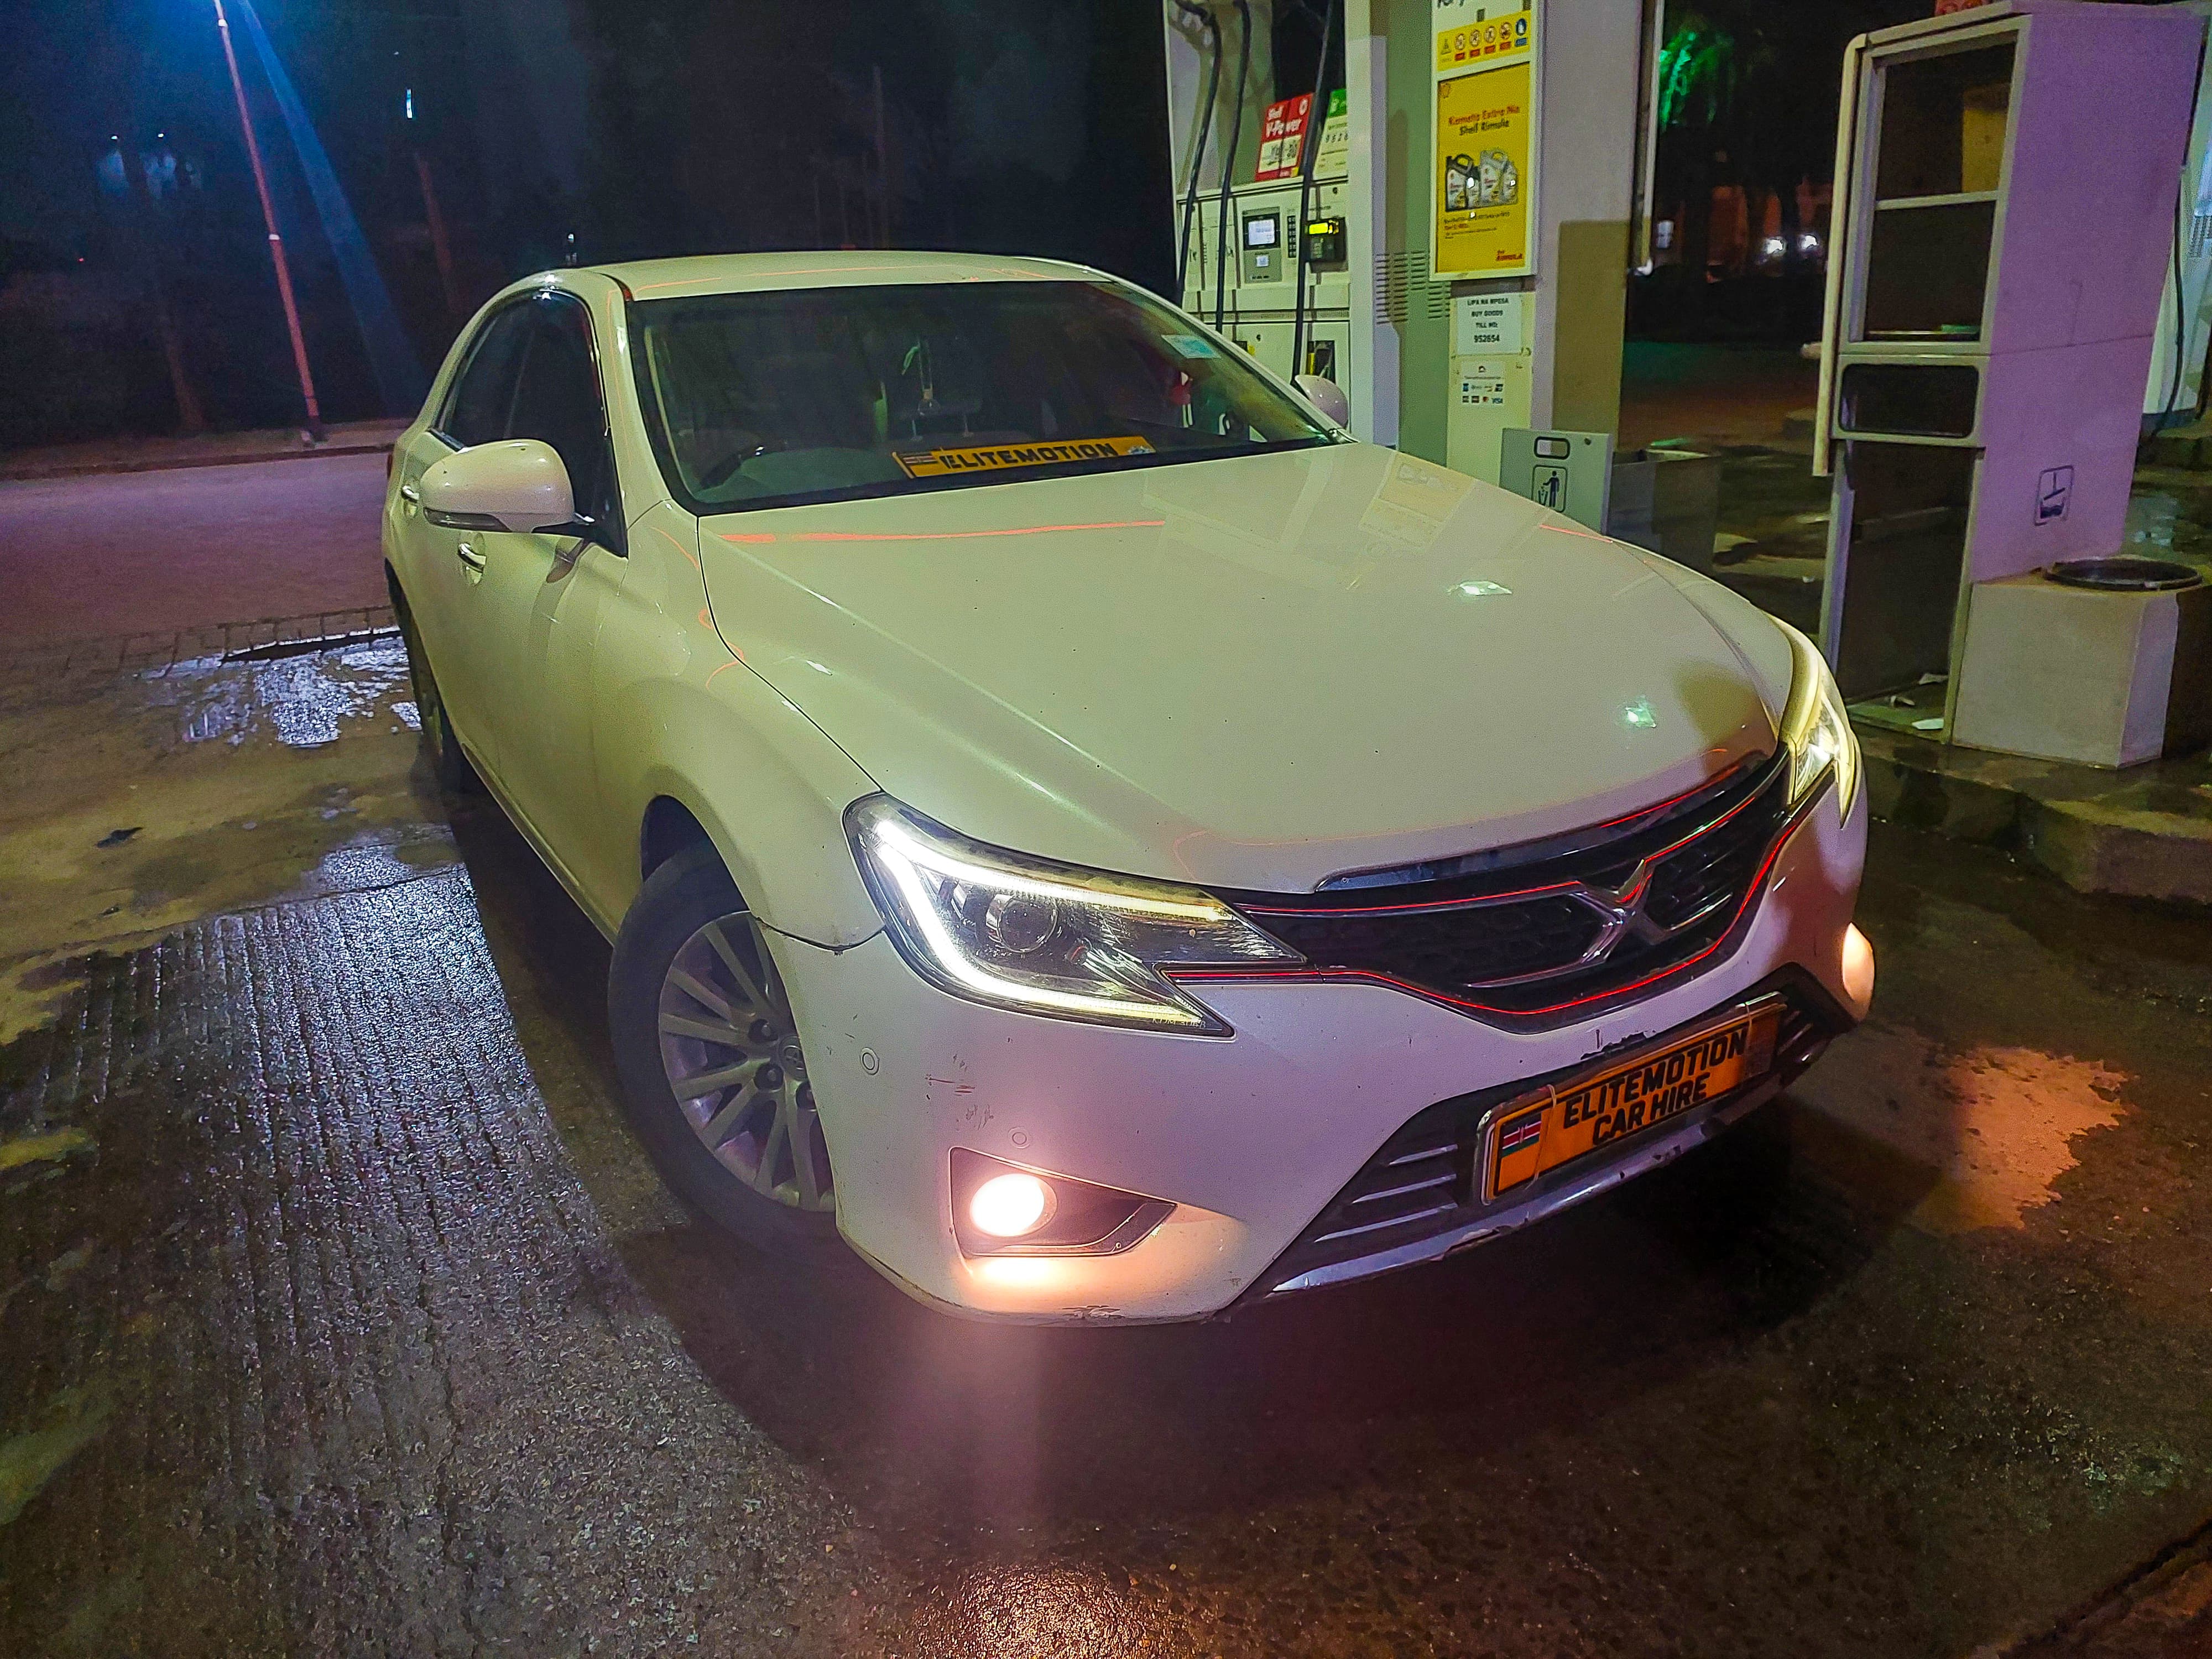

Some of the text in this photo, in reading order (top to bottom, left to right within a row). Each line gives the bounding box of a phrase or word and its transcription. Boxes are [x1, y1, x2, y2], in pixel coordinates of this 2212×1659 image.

[940, 442, 1118, 469] ELITEMOTION
[1563, 1028, 1747, 1129] ELITEMOTION
[1593, 1072, 1710, 1146] CAR HIRE
